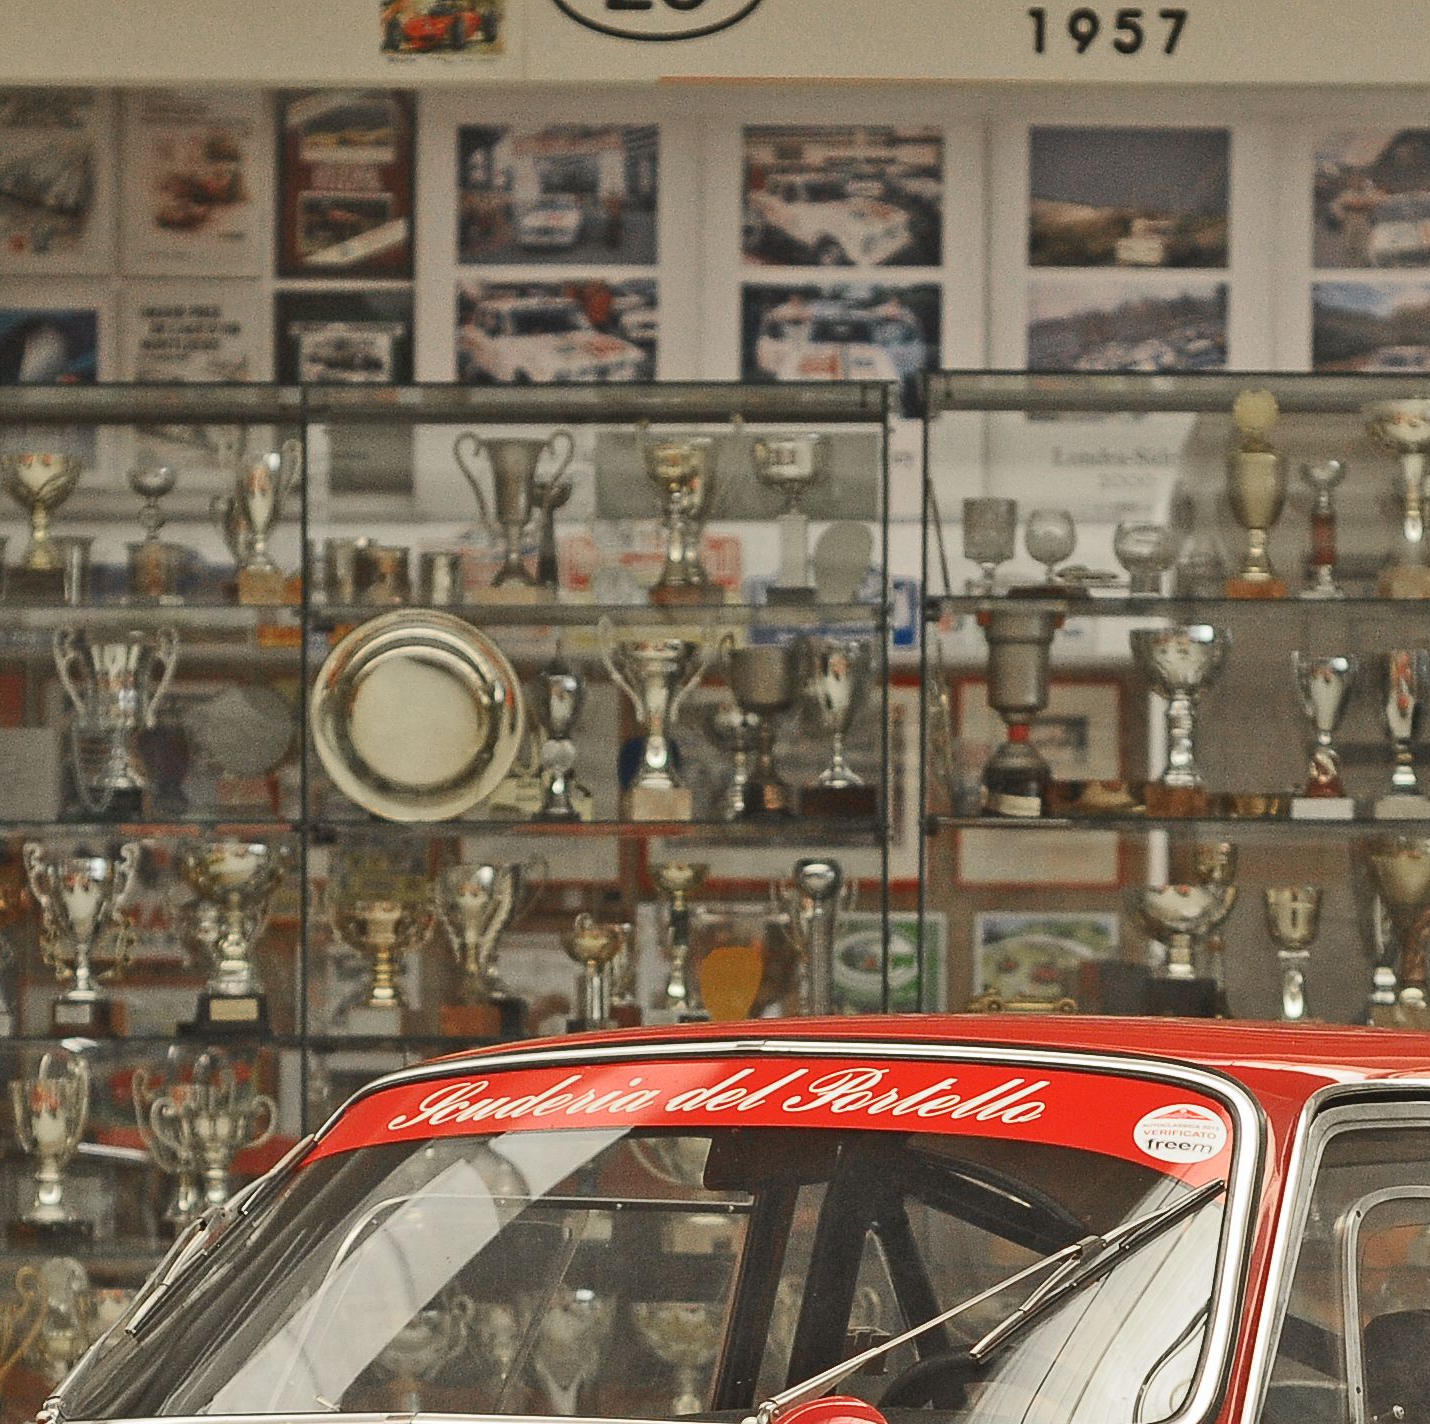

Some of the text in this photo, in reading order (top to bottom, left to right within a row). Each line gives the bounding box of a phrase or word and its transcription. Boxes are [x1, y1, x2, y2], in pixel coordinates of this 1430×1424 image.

[1028, 7, 1187, 54] 1957
[387, 1066, 1050, 1131] Scuderia del Portello
[1143, 1129, 1217, 1140] VERIFICATO
[1147, 1138, 1213, 1154] freem
